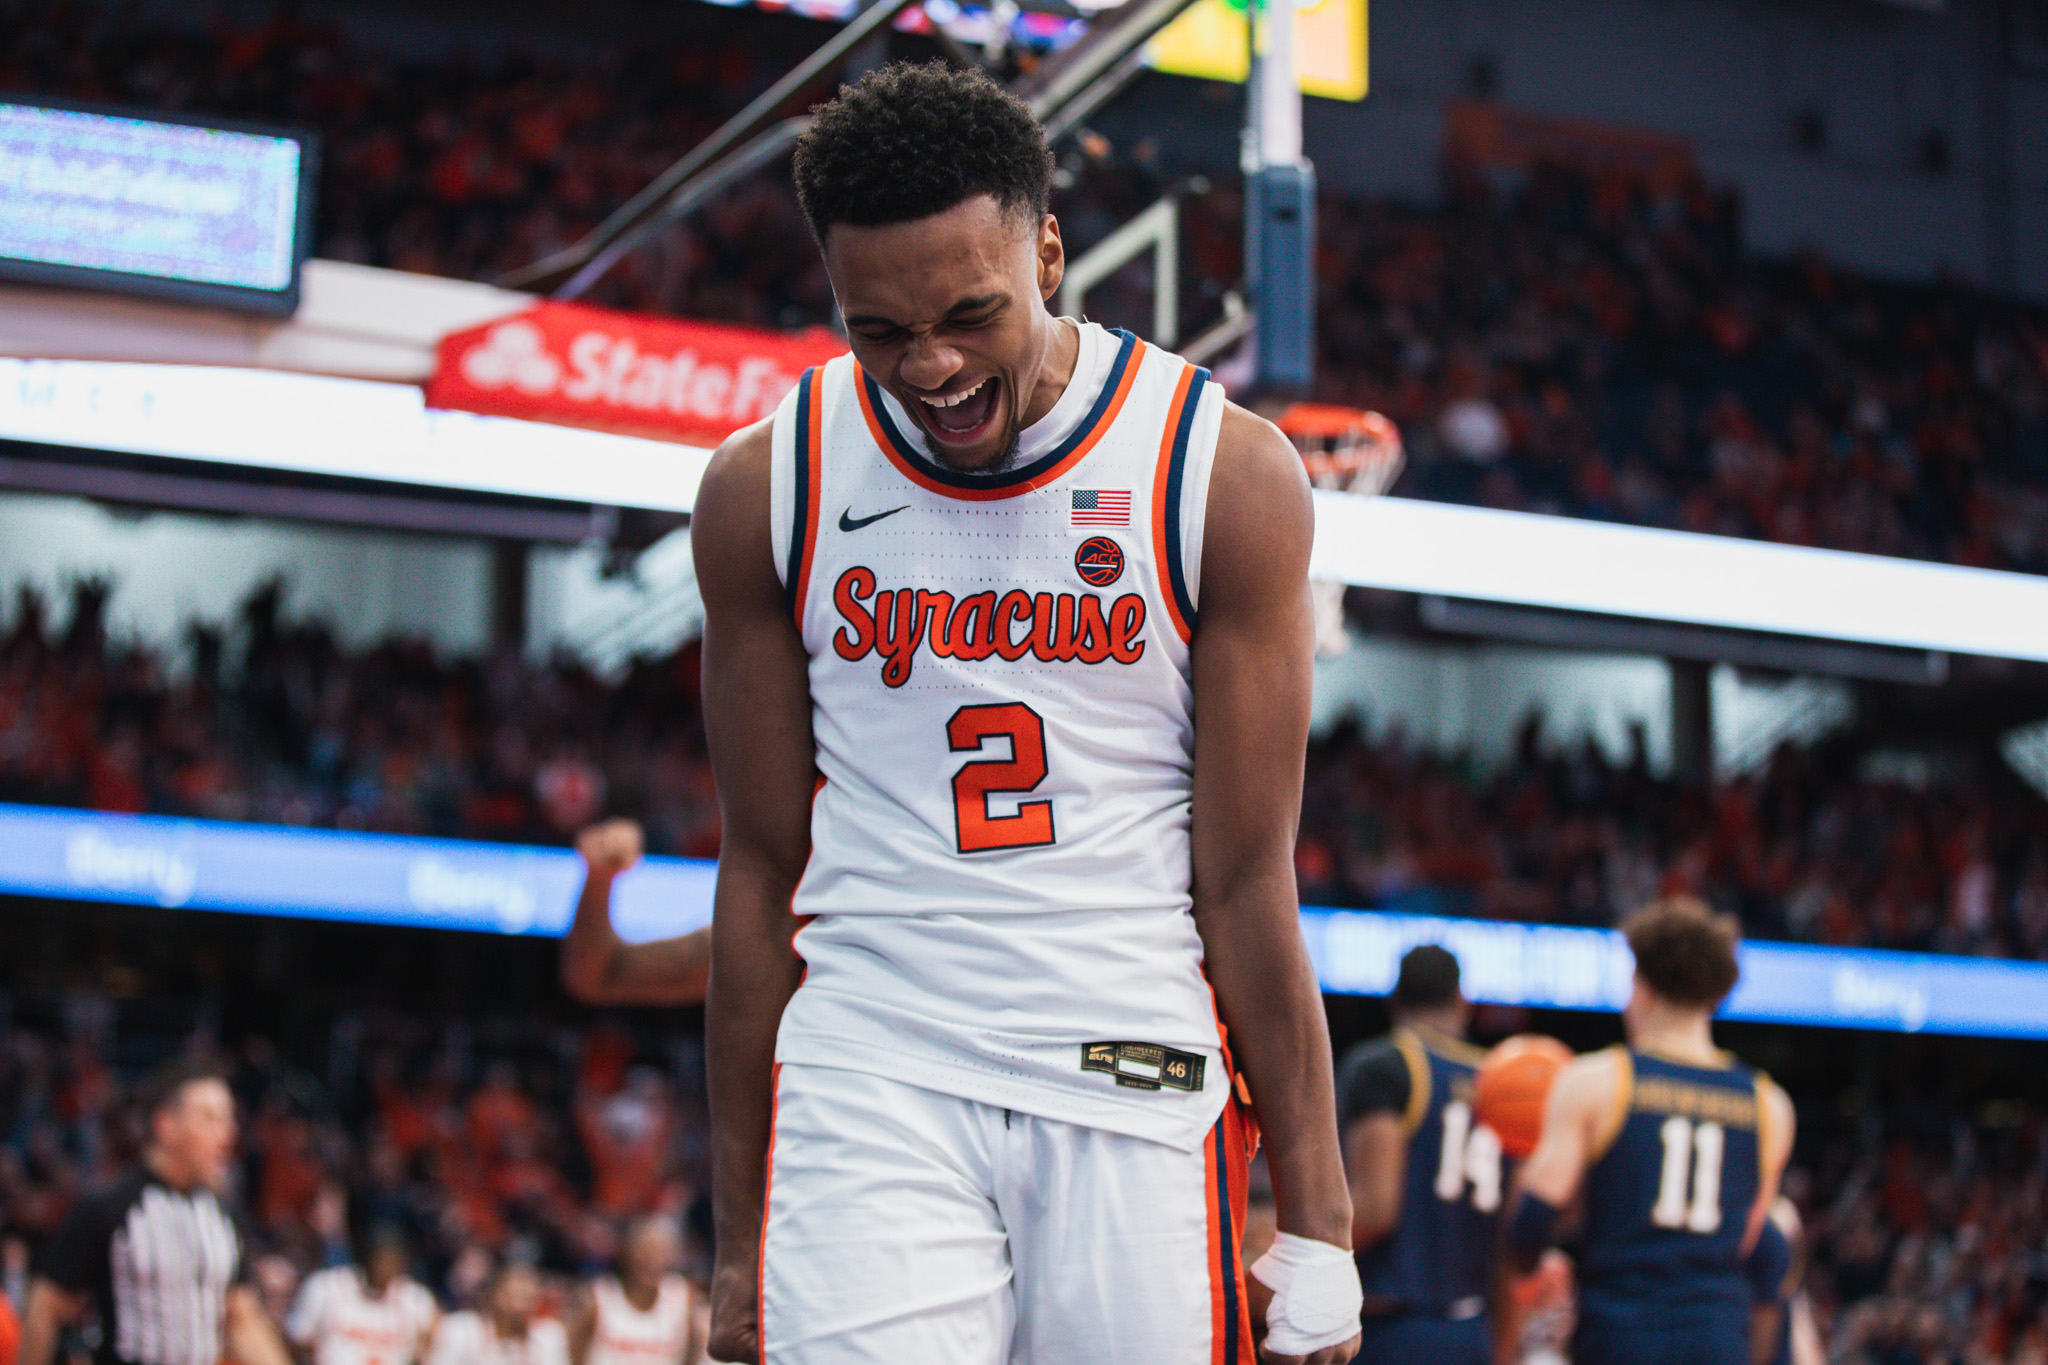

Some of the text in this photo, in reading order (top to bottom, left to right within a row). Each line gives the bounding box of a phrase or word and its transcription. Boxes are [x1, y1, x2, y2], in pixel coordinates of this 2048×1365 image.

[1083, 553, 1122, 565] ACC
[833, 566, 1146, 688] Syracuse
[945, 701, 1056, 854] 2
[1166, 1061, 1187, 1078] 46
[1652, 1116, 1724, 1234] 11
